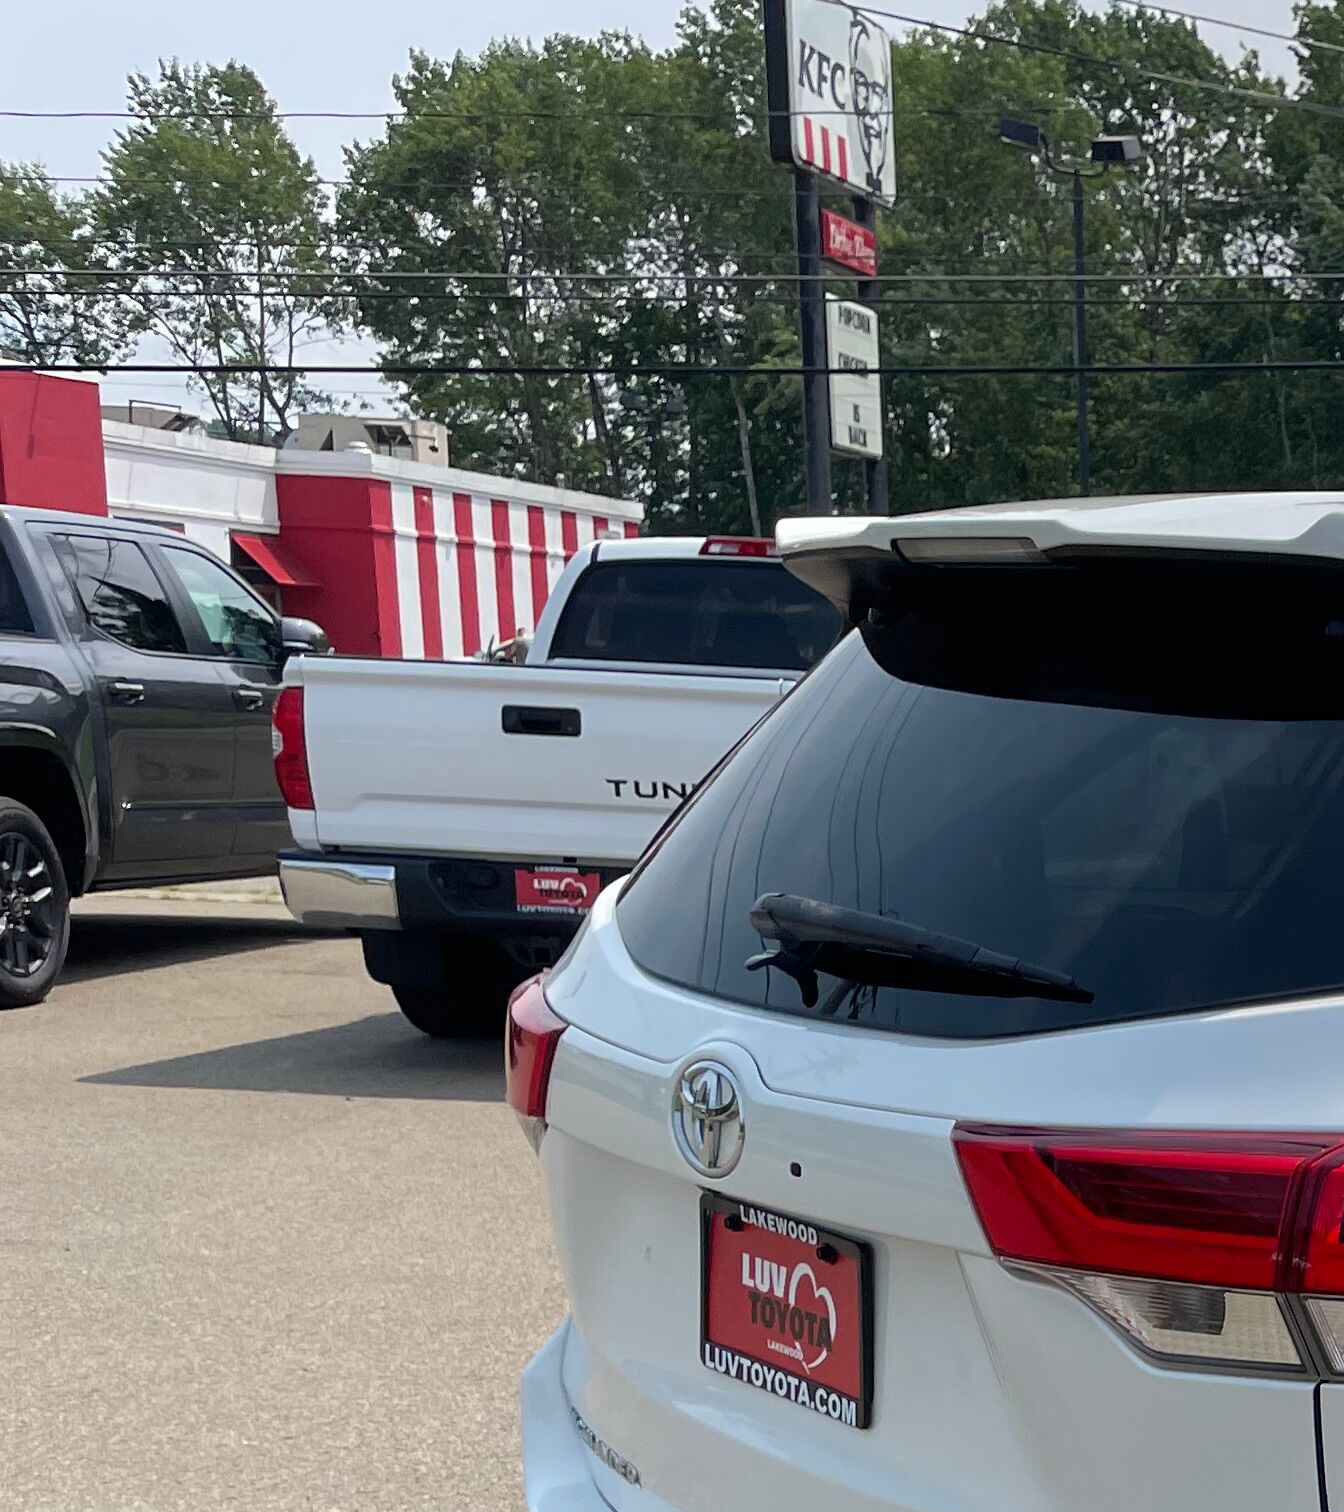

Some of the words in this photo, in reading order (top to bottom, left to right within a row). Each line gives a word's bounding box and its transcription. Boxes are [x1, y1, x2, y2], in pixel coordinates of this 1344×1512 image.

[799, 38, 846, 111] KFC
[739, 1203, 819, 1247] LAKEWOOD
[741, 1252, 788, 1299] LUV
[748, 1290, 832, 1353] TOYOTA
[704, 1342, 857, 1428] LUVTOYOTA.COM
